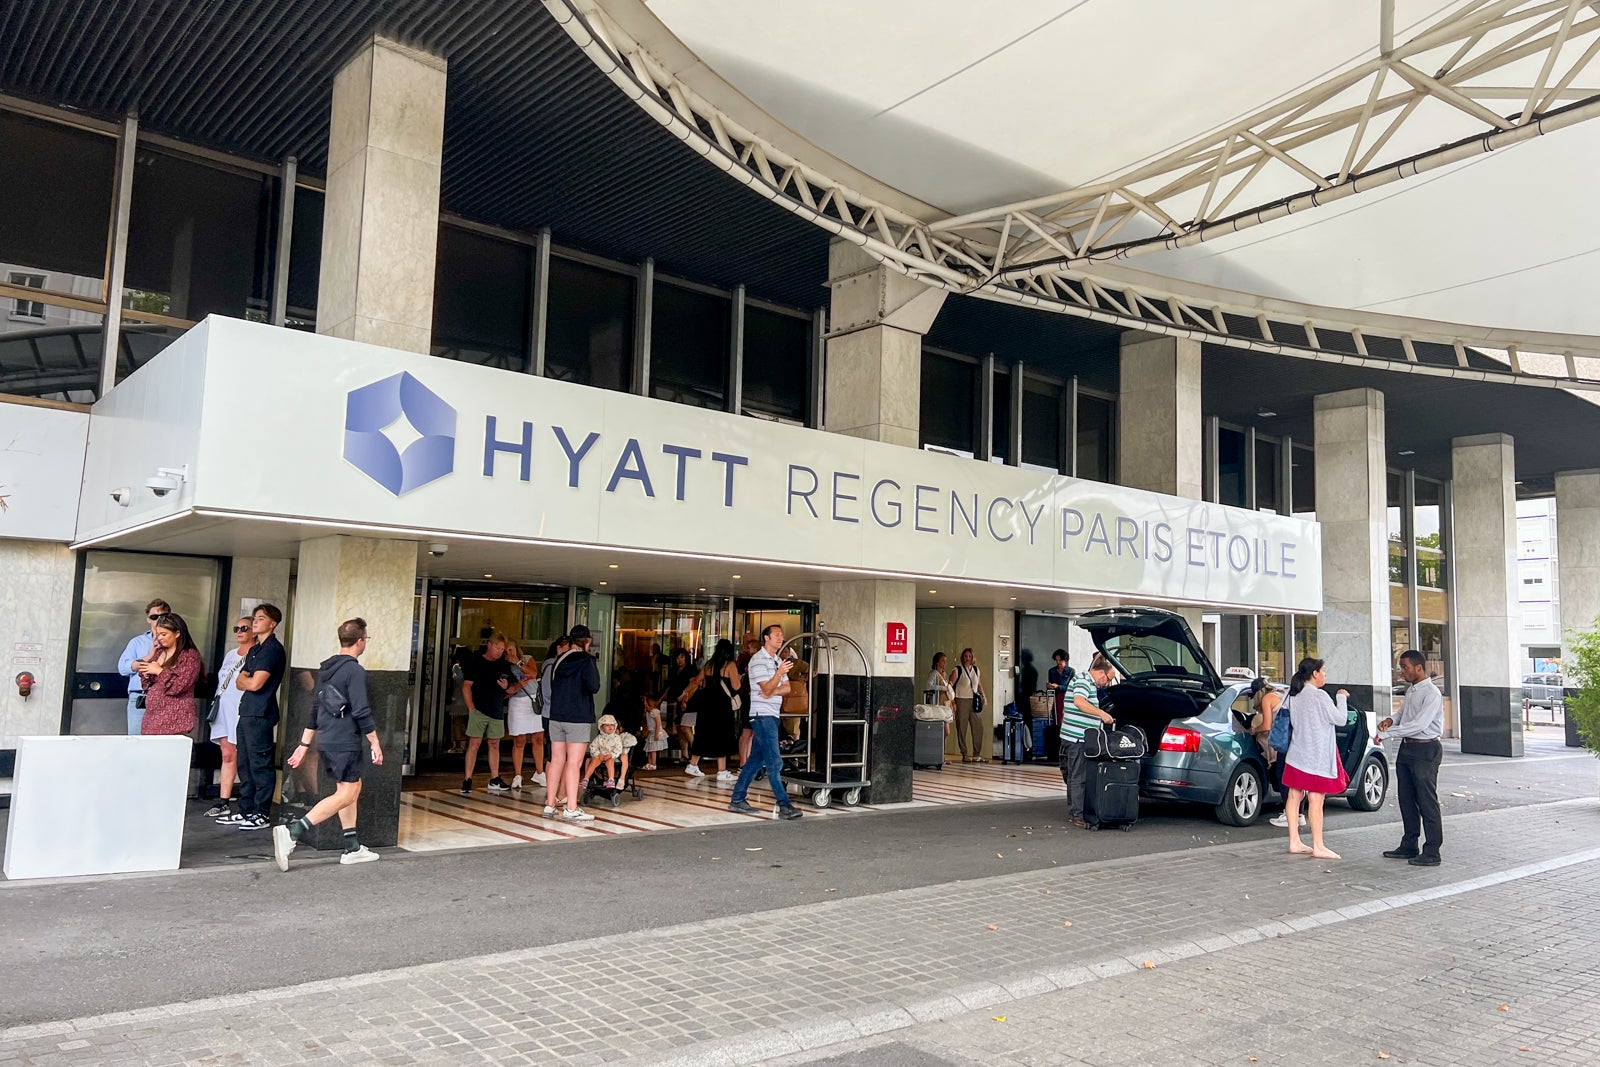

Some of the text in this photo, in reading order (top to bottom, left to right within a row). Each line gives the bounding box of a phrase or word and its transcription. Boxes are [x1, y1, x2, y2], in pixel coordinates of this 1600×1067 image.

[483, 415, 1297, 579] HYATT REGENCY PARIS ETOILE
[895, 628, 905, 641] H
